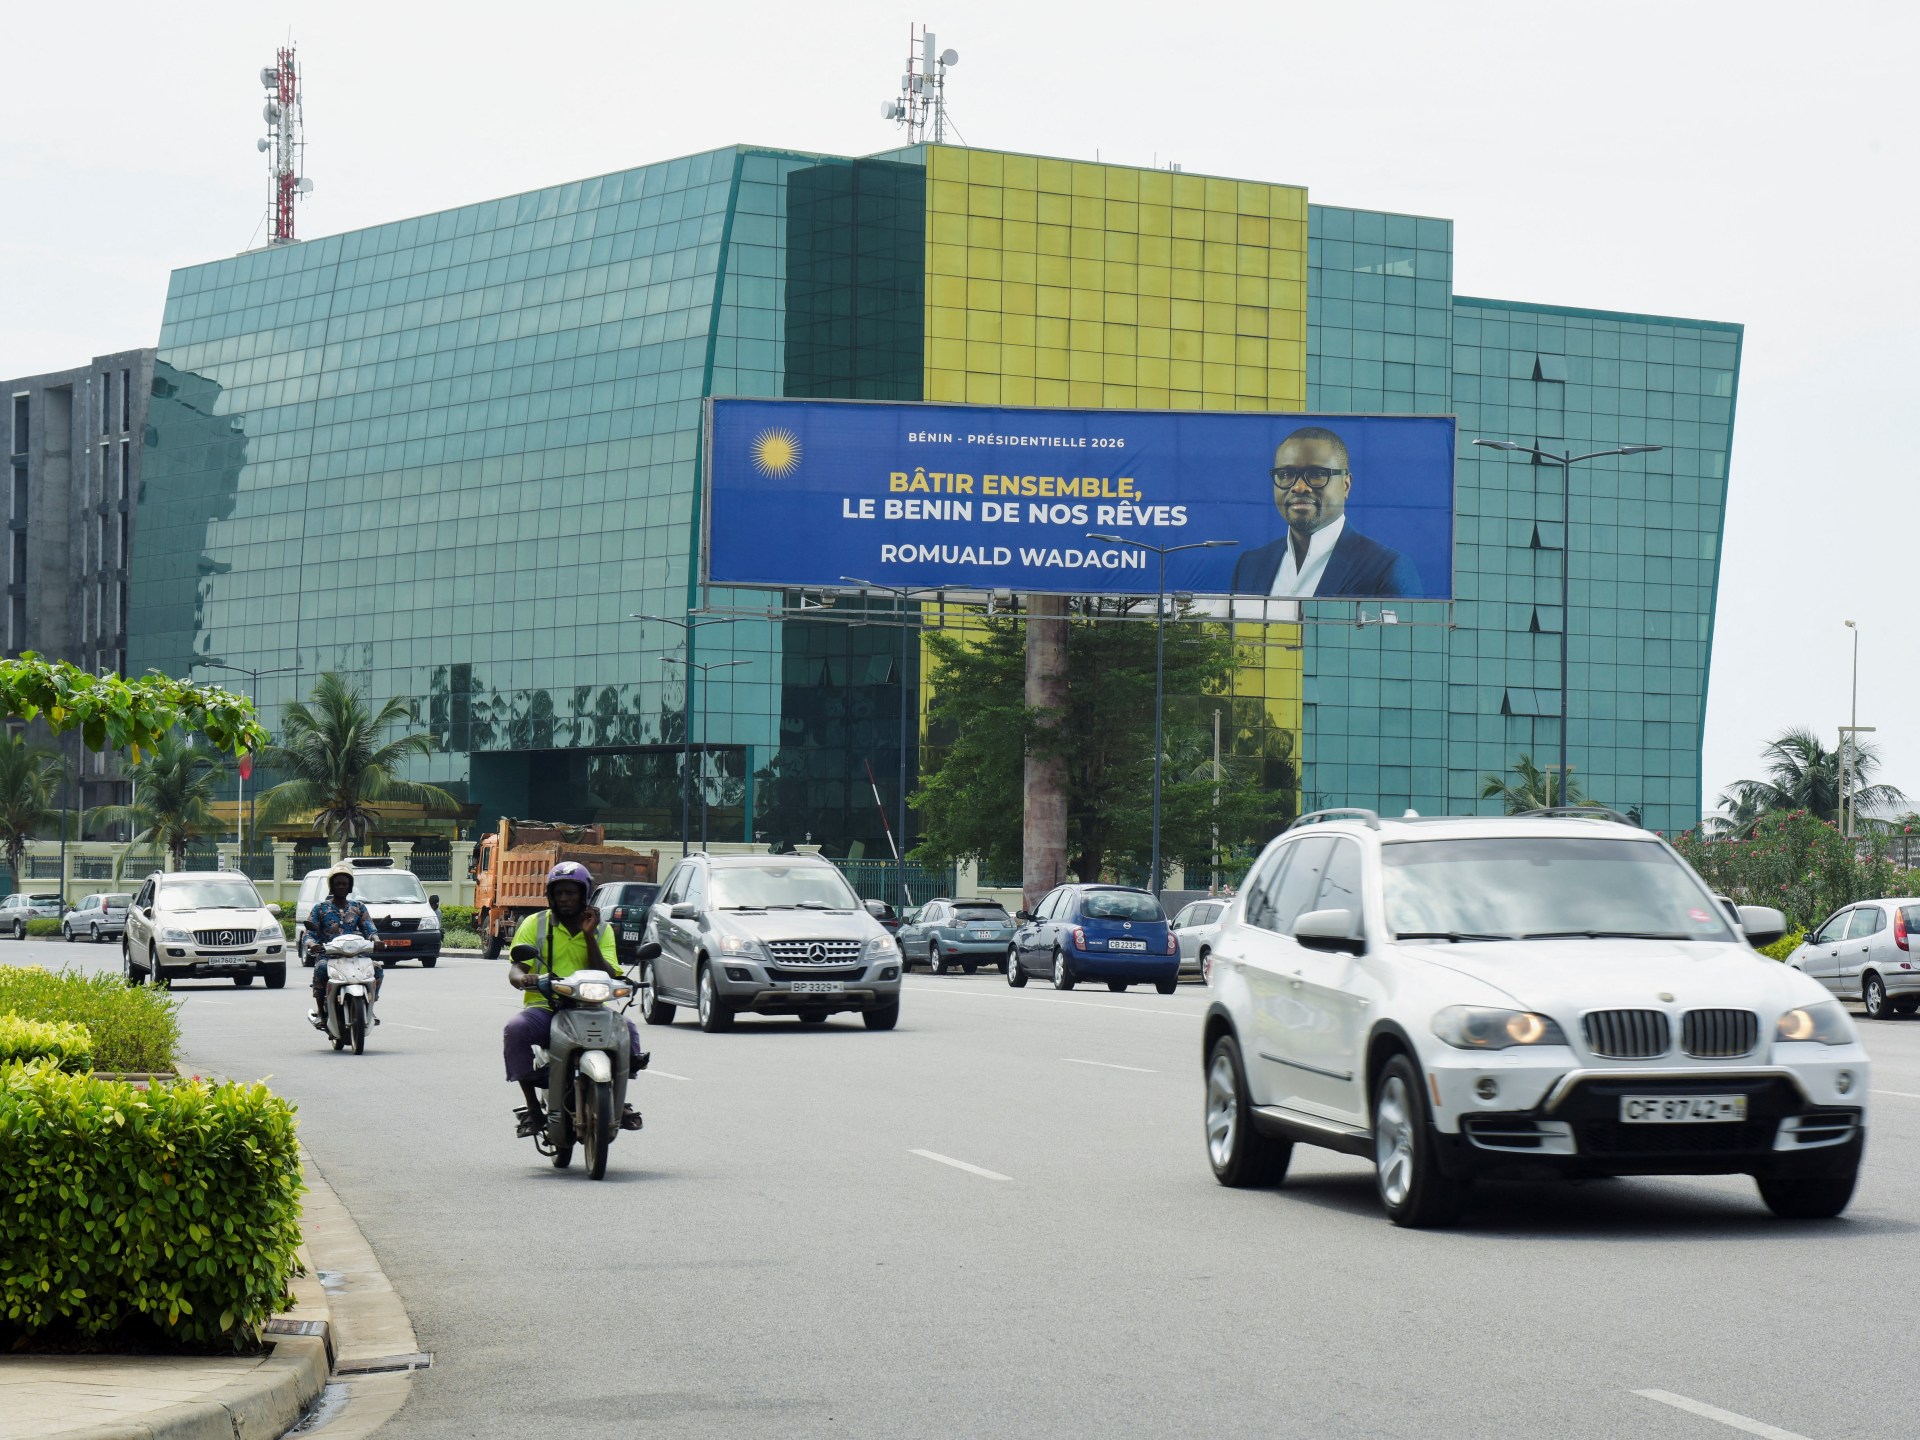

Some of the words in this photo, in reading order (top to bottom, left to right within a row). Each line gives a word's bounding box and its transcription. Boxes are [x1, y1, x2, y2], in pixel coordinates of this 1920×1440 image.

[908, 431, 953, 443] BÉNIN
[967, 433, 1087, 448] PRÉSIDENTIELLE
[1091, 438, 1125, 448] 2026
[889, 467, 974, 494] BÂTIR
[983, 474, 1142, 502] ENSEMBLE,
[843, 498, 876, 519] LE
[884, 499, 972, 521] BENIN
[982, 502, 1020, 523] DE
[1029, 503, 1089, 525] NOS
[1097, 500, 1188, 526] RÊVES
[881, 544, 1012, 566] ROMUALD
[1019, 547, 1147, 569] WADAGNI
[1121, 941, 1137, 949] 2235
[793, 982, 807, 992] BP
[808, 983, 832, 992] 3329
[1626, 1099, 1659, 1120] CF
[1661, 1099, 1718, 1120] 8742
